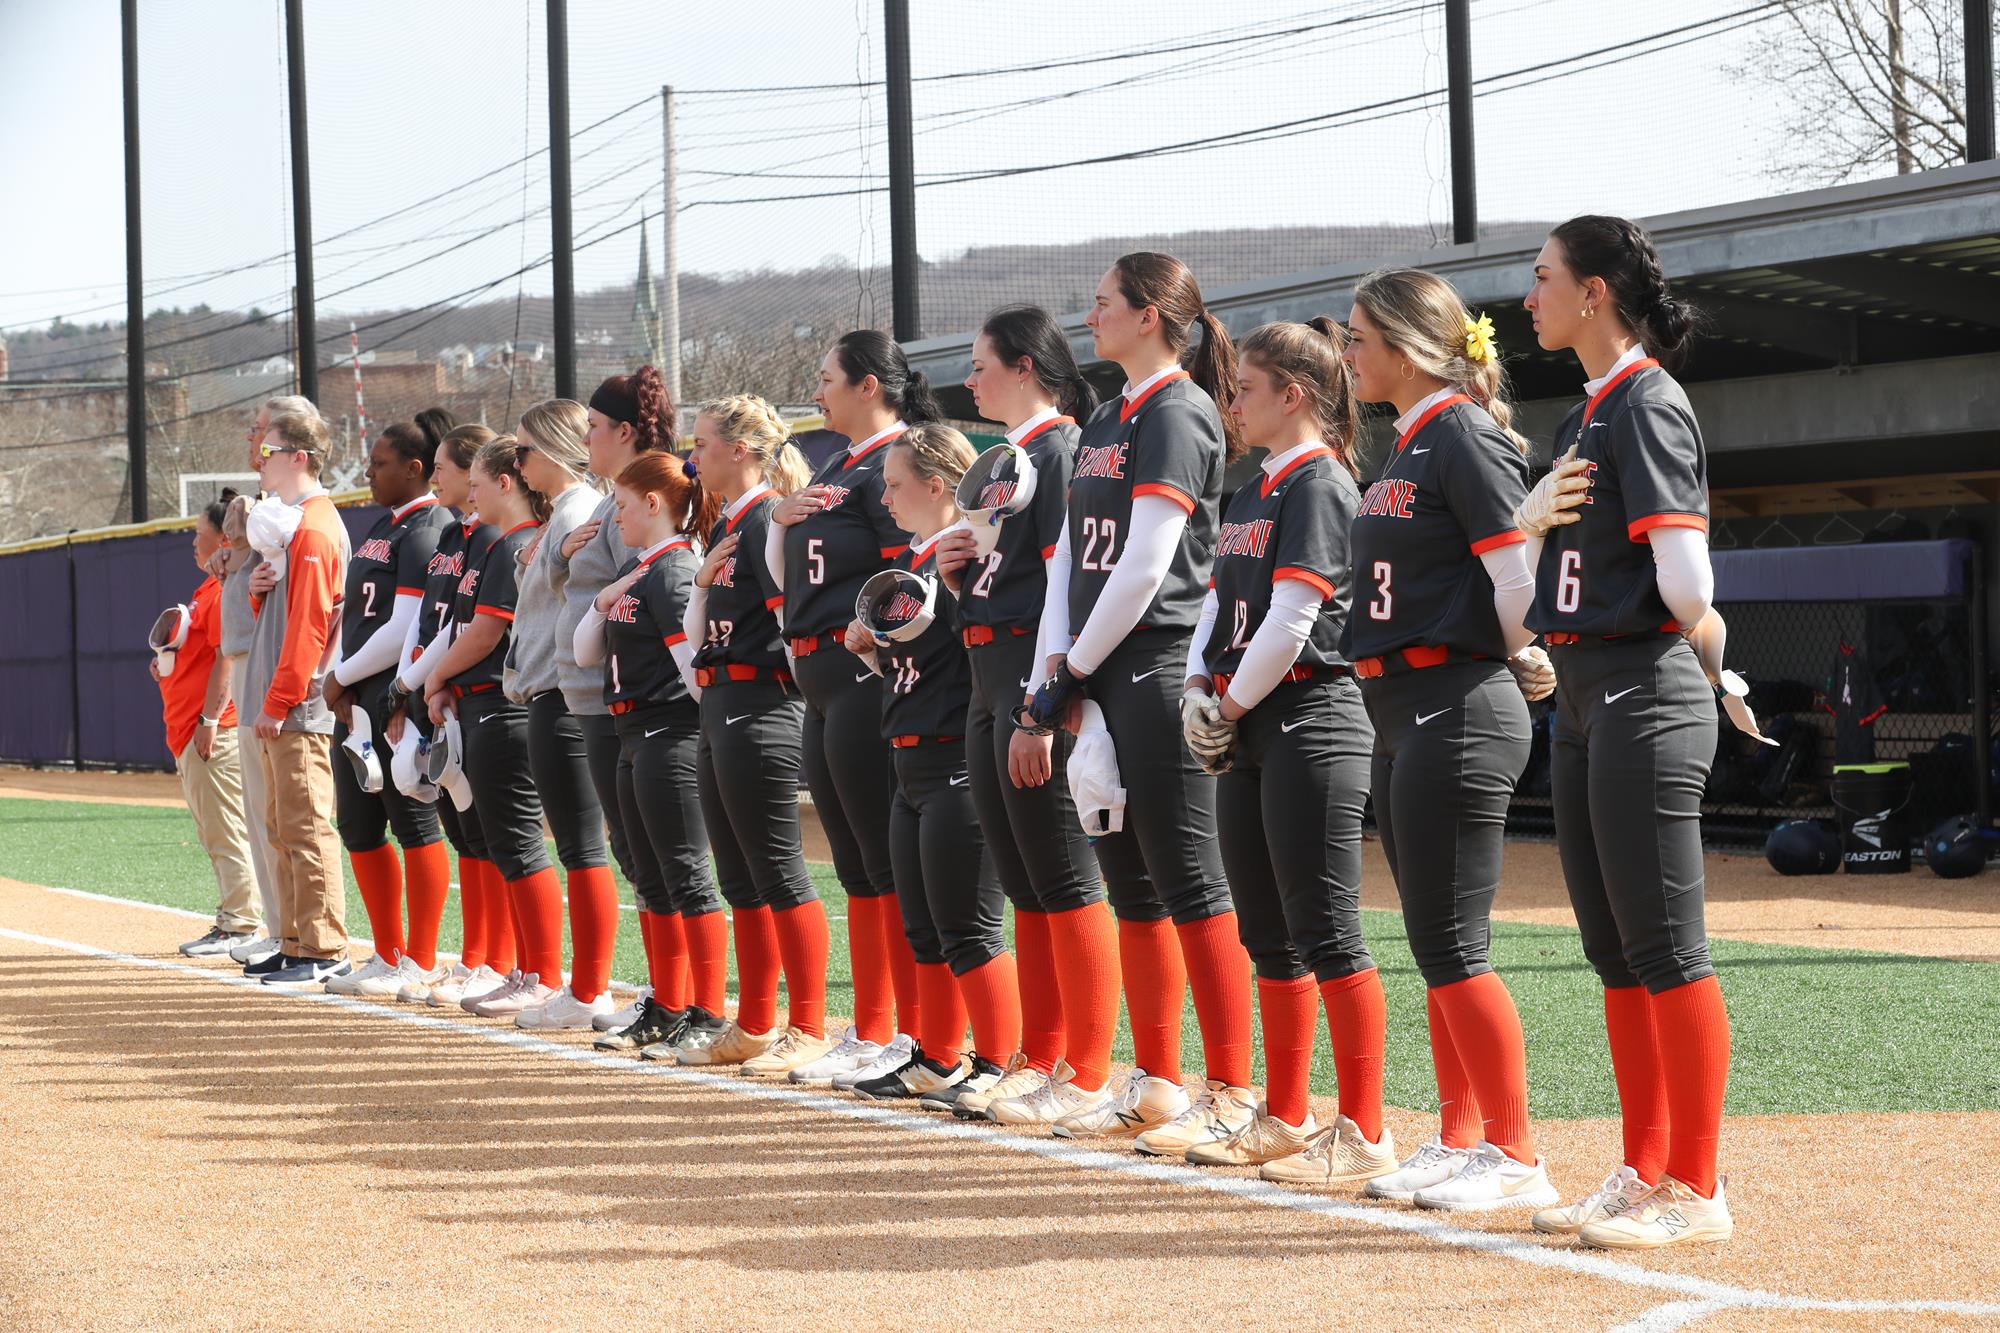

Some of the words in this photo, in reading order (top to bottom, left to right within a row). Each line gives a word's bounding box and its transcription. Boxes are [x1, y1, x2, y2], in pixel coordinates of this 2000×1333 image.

[807, 538, 825, 585] 5
[1082, 516, 1117, 571] 22
[362, 581, 377, 617] 2
[1370, 560, 1392, 620] 3
[1556, 549, 1581, 613] 6
[434, 601, 449, 635] 7
[1844, 849, 1902, 862] EASTON
